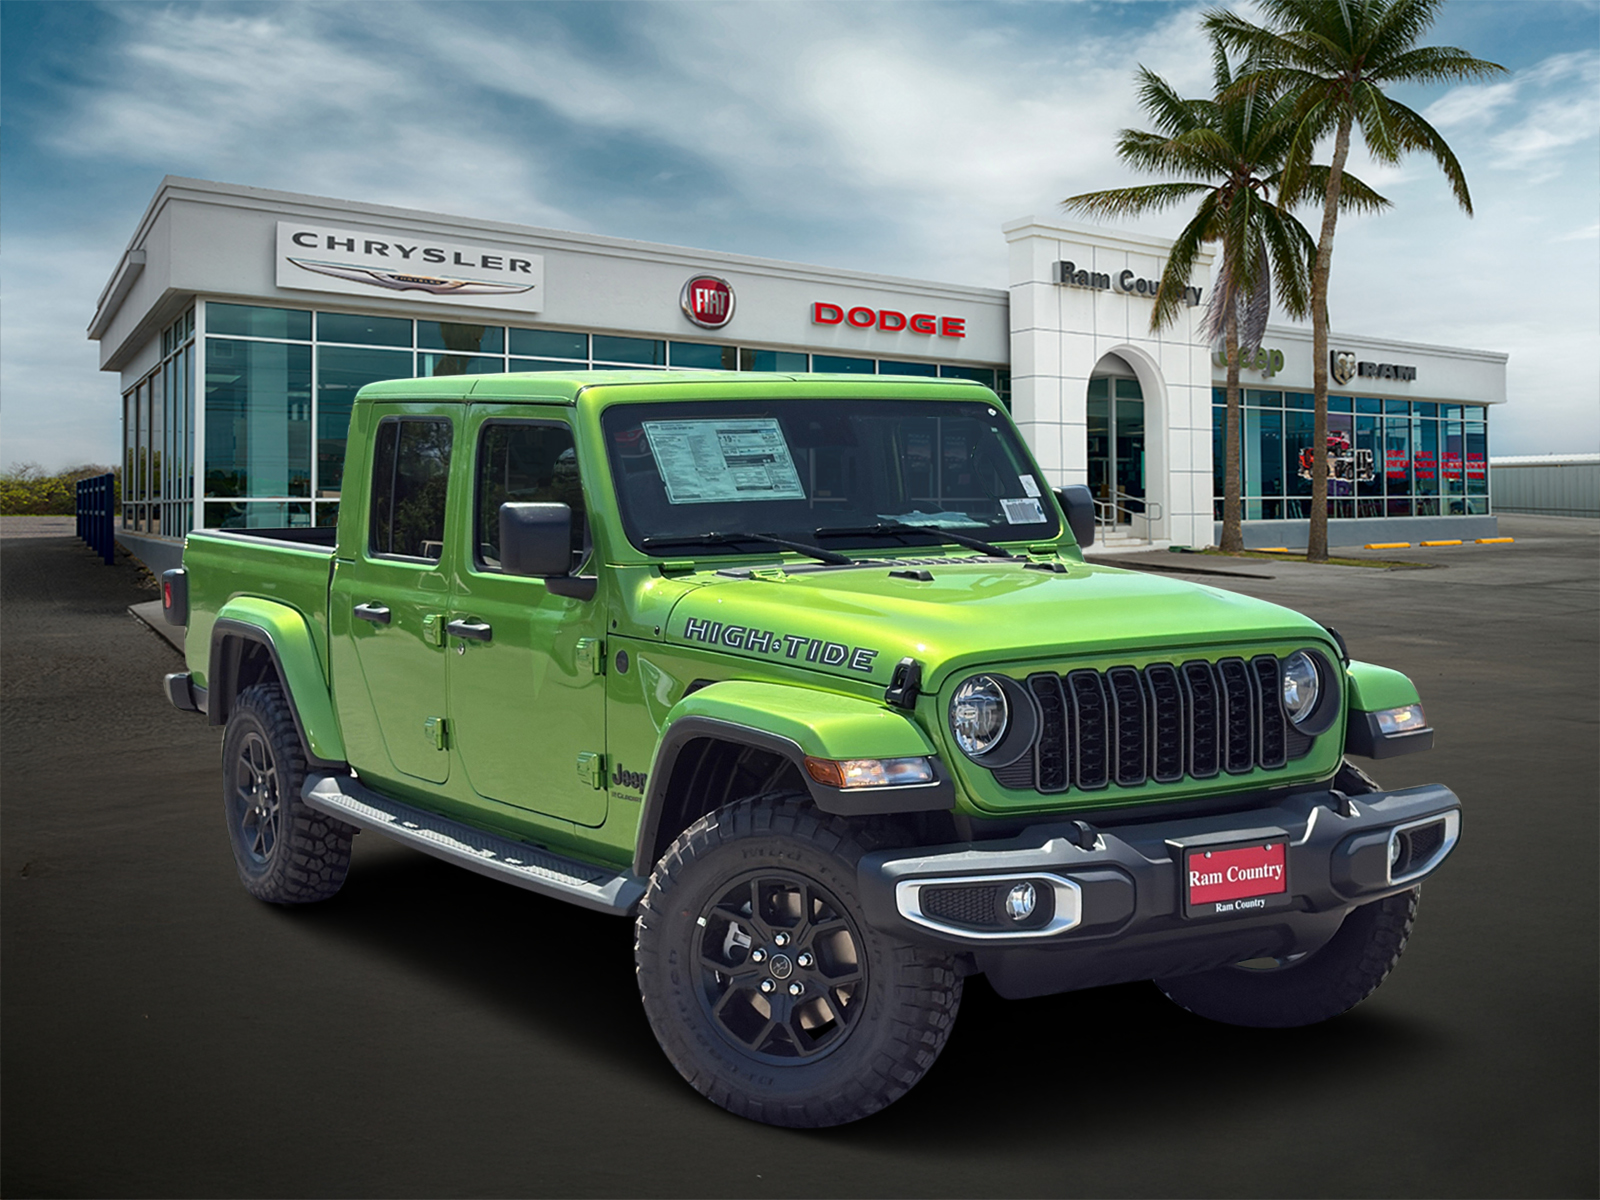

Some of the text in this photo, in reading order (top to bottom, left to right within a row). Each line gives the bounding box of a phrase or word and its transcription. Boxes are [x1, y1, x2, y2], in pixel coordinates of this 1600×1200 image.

[292, 231, 532, 274] CHRYSLER
[1058, 260, 1111, 290] Ram
[695, 288, 728, 316] FIAT
[813, 301, 967, 339] DODGE
[1358, 361, 1417, 380] RAM
[683, 617, 880, 673] HIGH TIDE
[611, 762, 648, 795] Jeep
[1189, 863, 1284, 887] Ram Country
[1215, 898, 1266, 912] Ram Country
